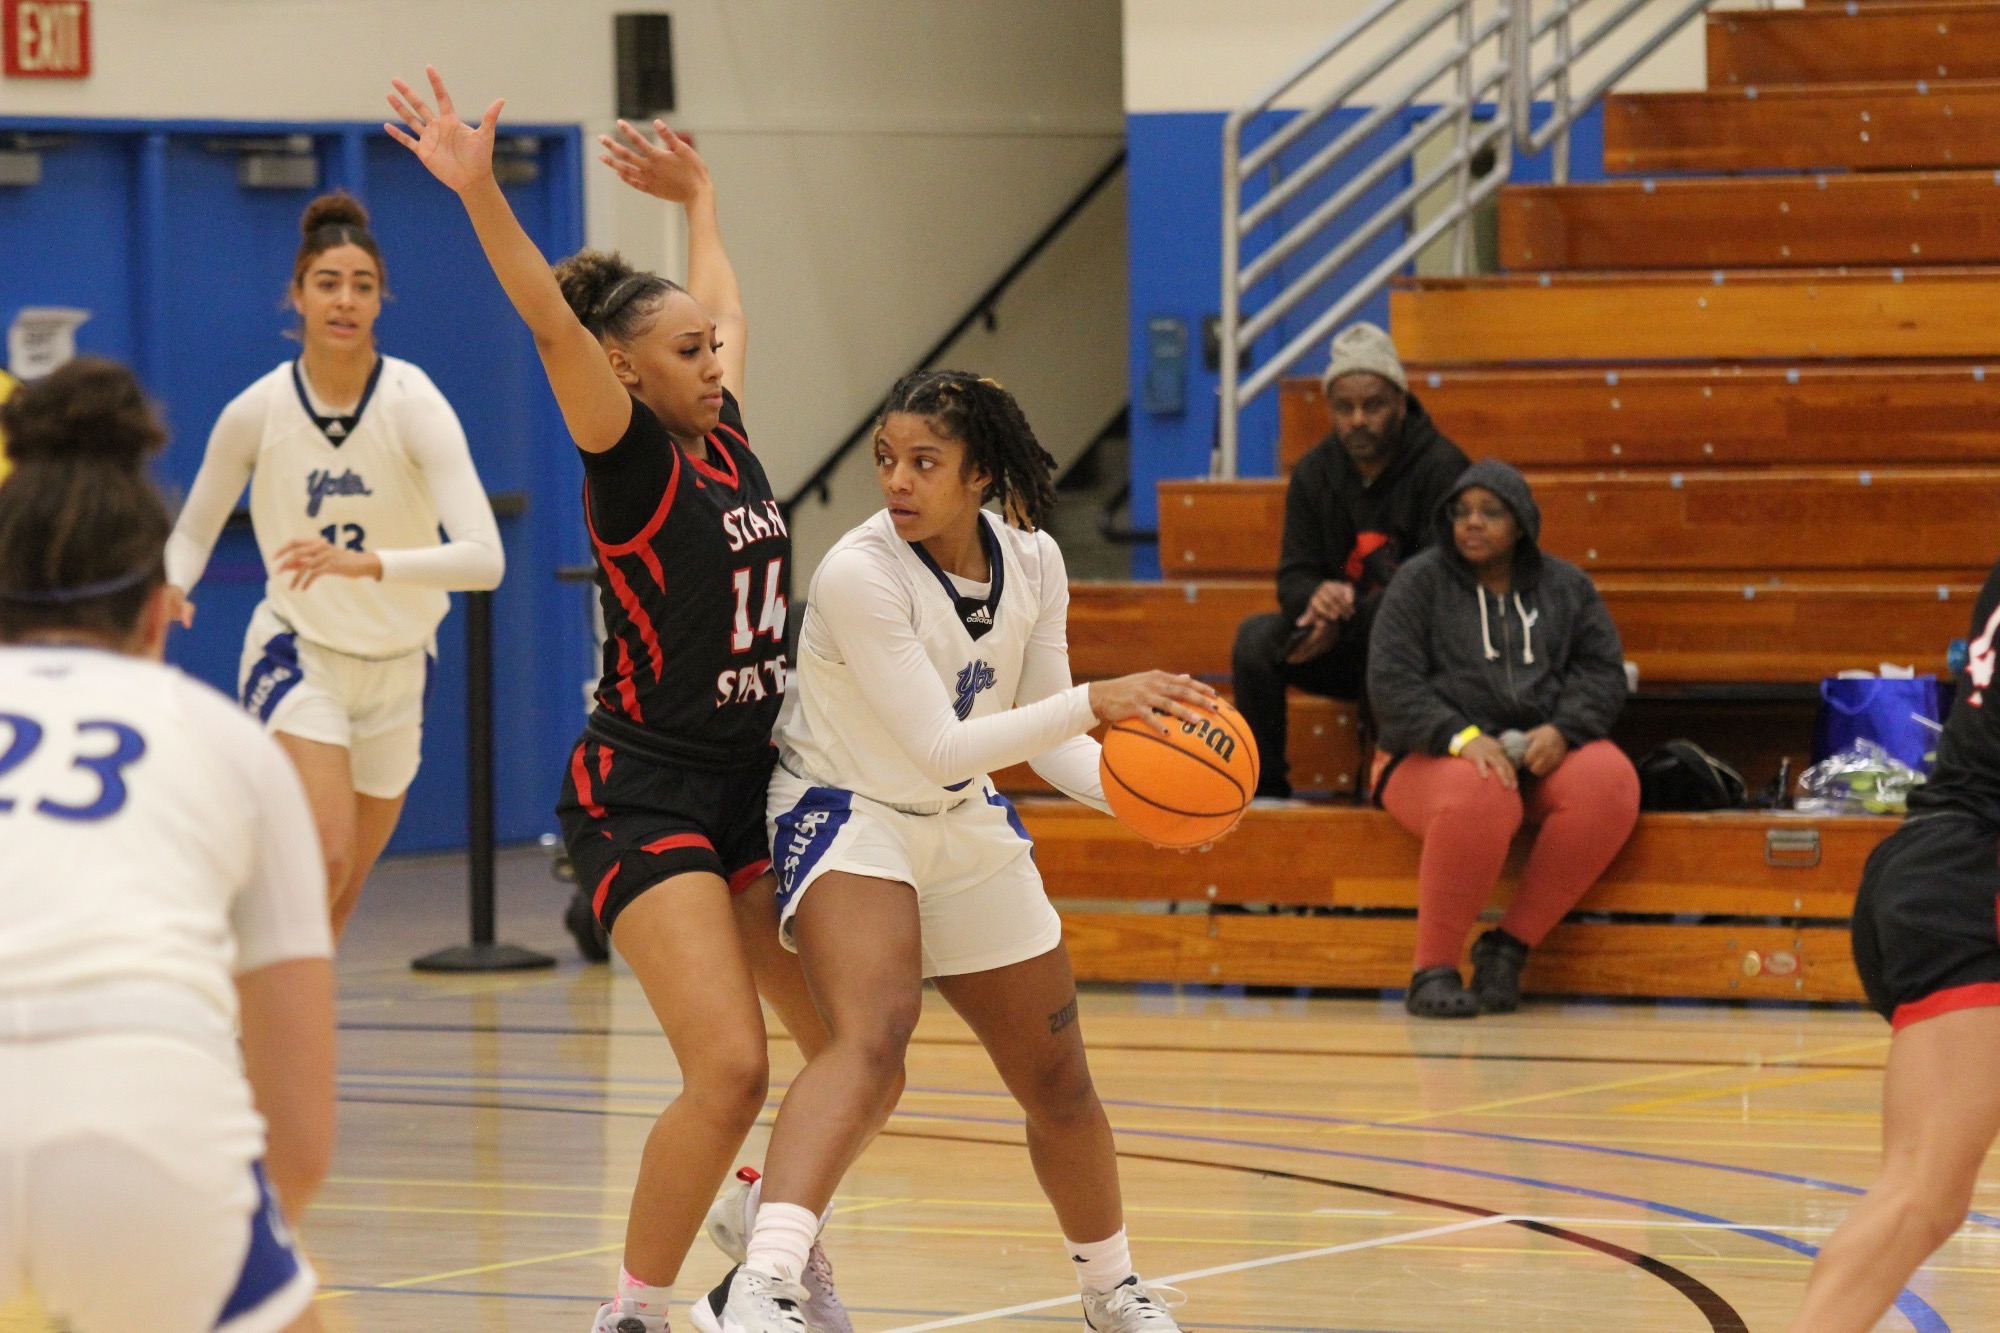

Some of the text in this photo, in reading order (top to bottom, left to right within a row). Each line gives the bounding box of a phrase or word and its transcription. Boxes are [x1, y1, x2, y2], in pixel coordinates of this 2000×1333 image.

[18, 2, 81, 71] EXIT
[731, 556, 787, 654] 14
[966, 616, 993, 625] adidas
[0, 712, 147, 823] 23
[783, 810, 830, 893] CSUSB
